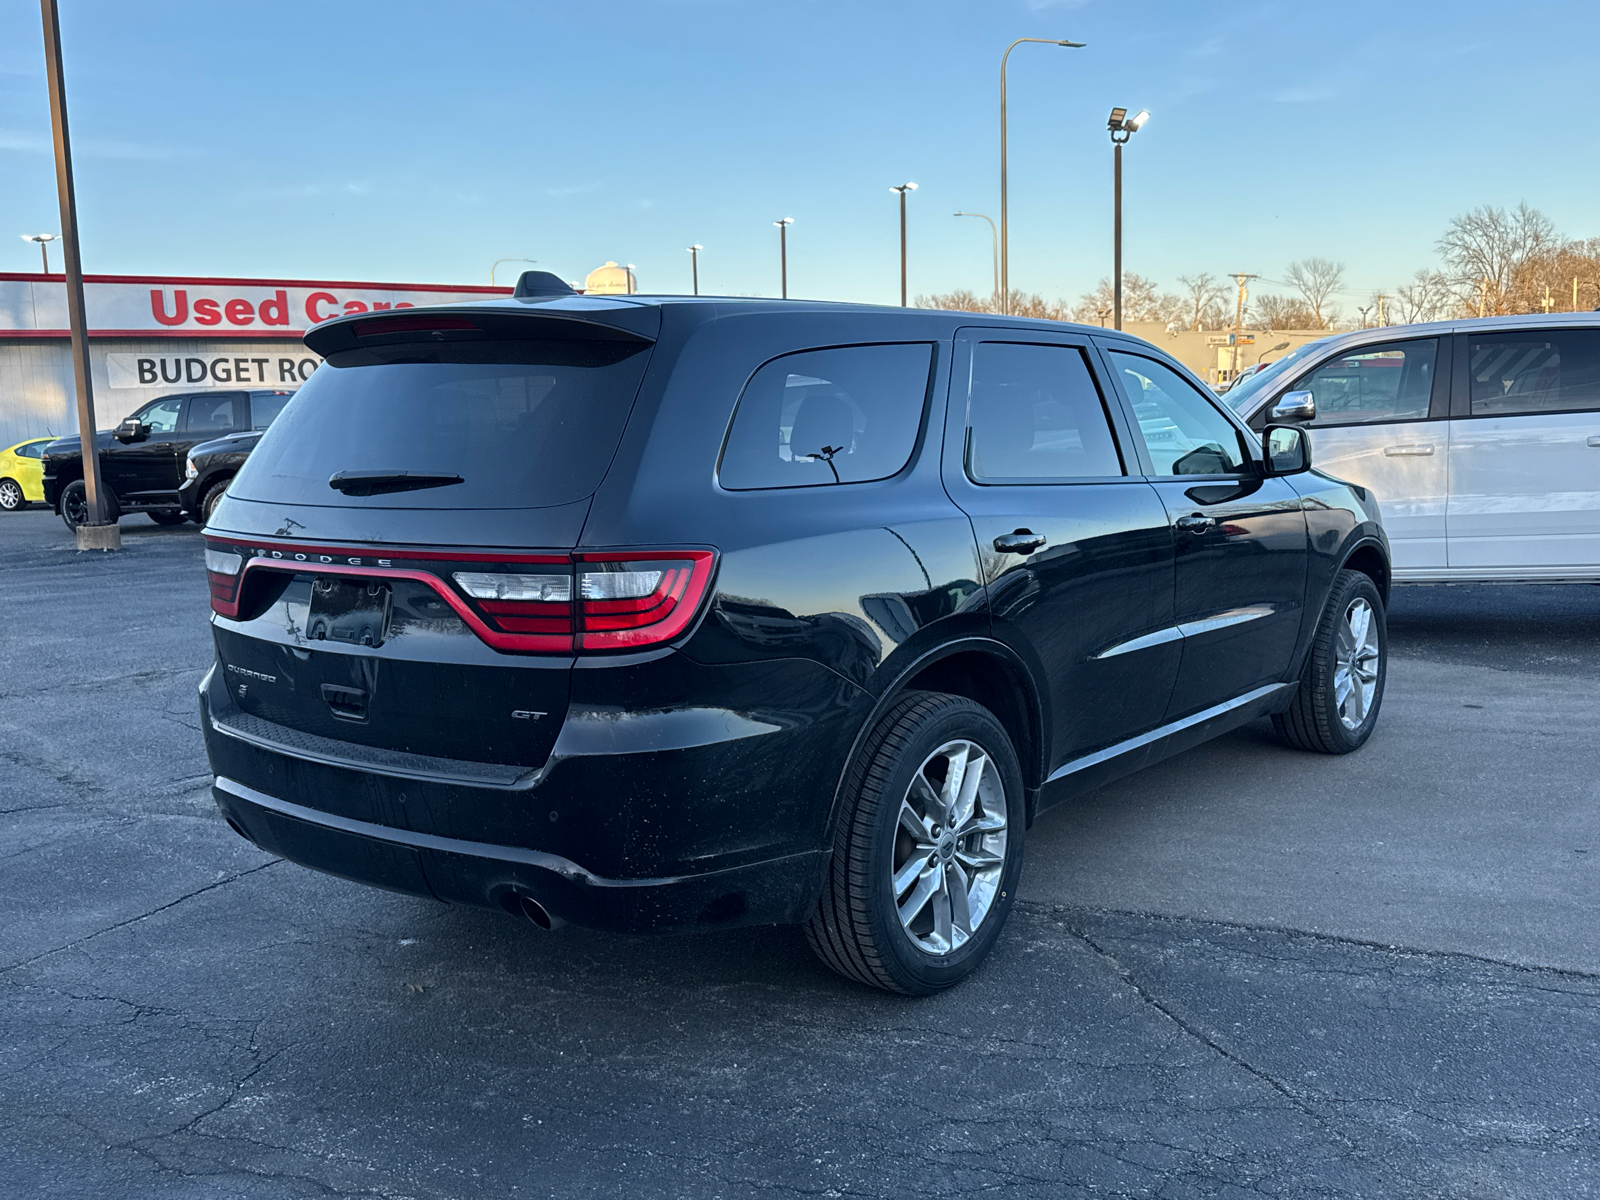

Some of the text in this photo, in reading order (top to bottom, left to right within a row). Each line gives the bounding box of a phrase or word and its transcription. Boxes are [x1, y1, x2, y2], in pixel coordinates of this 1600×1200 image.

[150, 289, 415, 326] Used Ca
[138, 357, 325, 384] BUDGET RO
[272, 551, 392, 567] DODGE
[227, 664, 277, 684] DURANGO
[511, 710, 548, 721] GT
